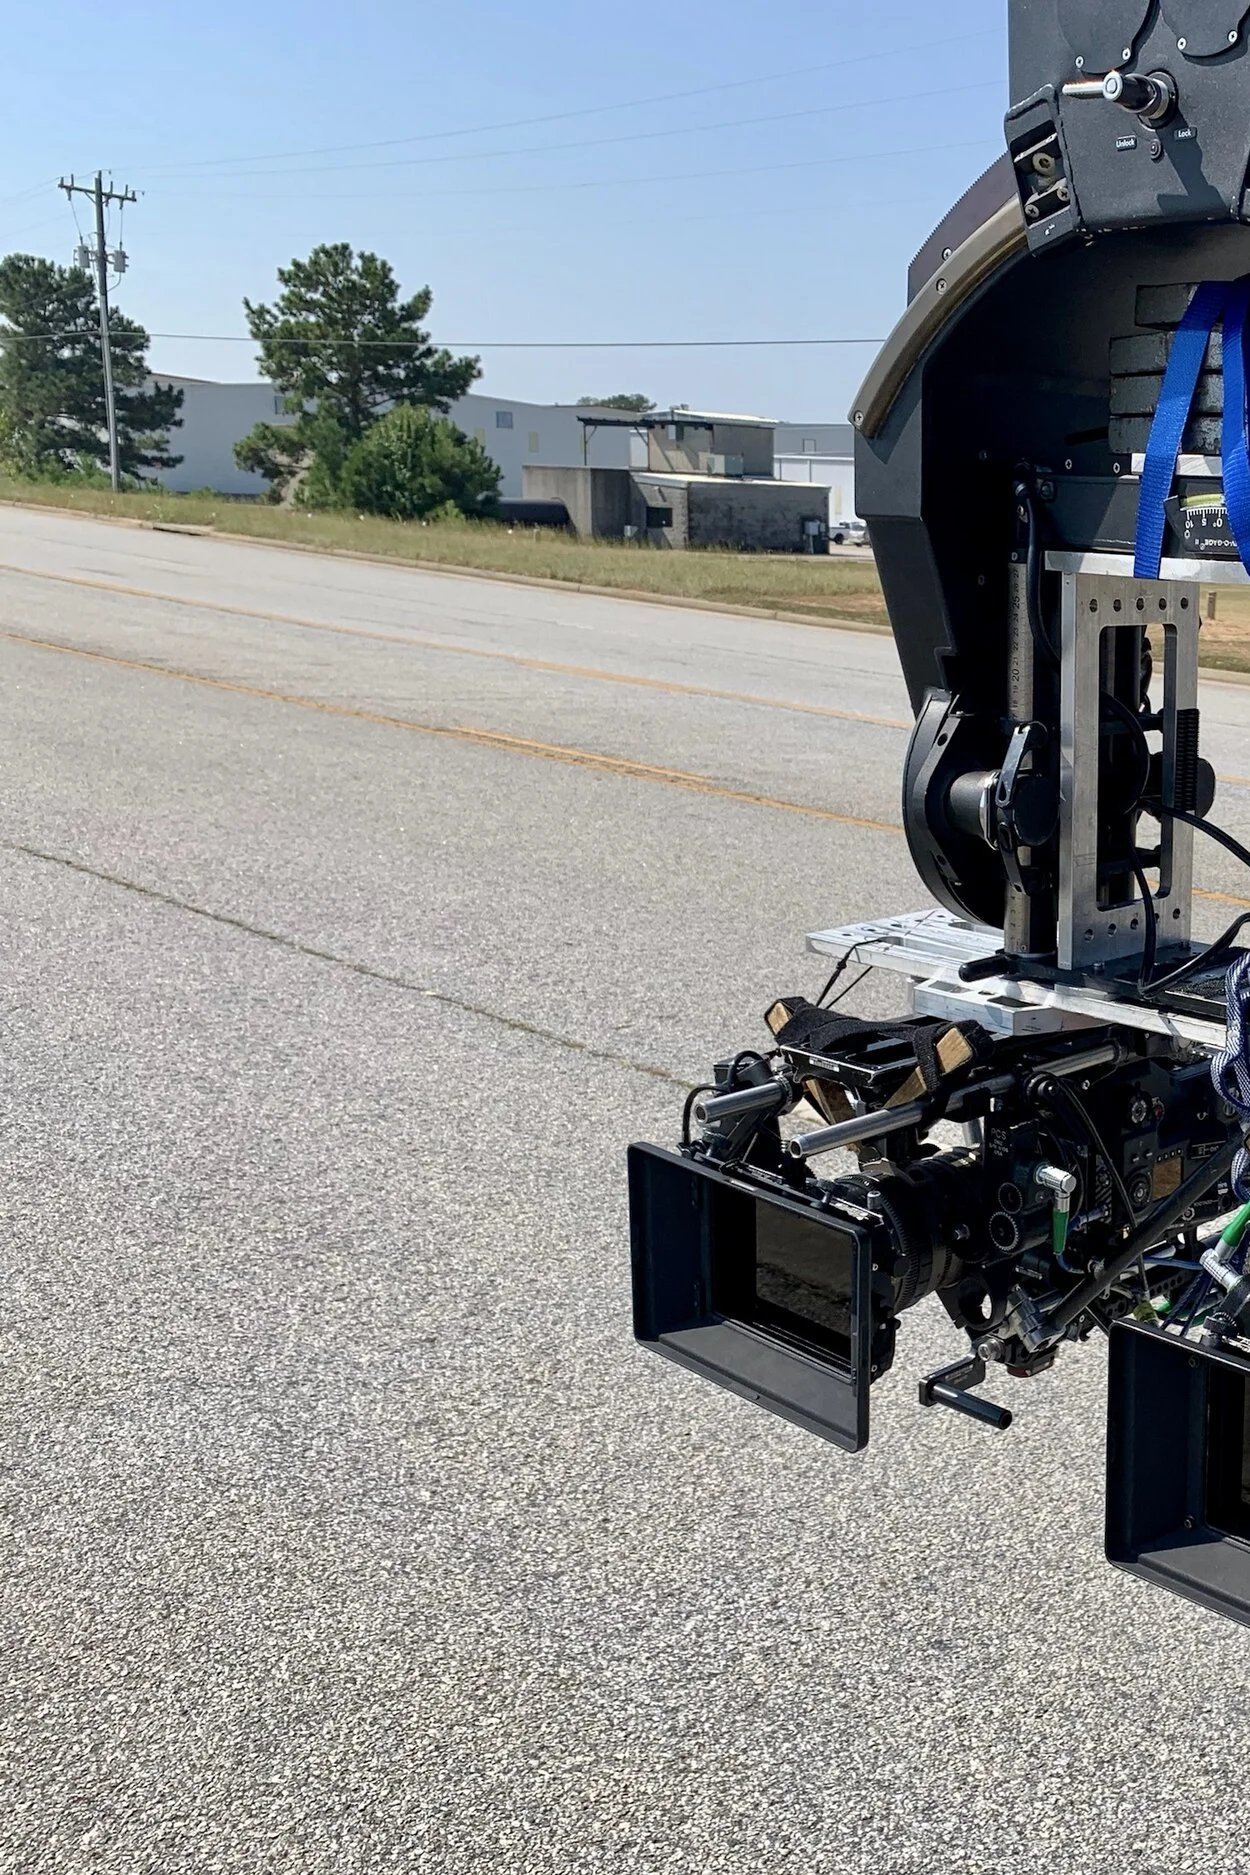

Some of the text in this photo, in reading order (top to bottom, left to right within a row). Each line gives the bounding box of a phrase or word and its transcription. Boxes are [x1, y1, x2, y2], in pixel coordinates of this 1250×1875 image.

[1178, 129, 1192, 138] Lock
[1115, 138, 1135, 148] Unlock
[1201, 518, 1207, 527] 5
[1011, 595, 1020, 610] 25
[1011, 668, 1020, 682] 20
